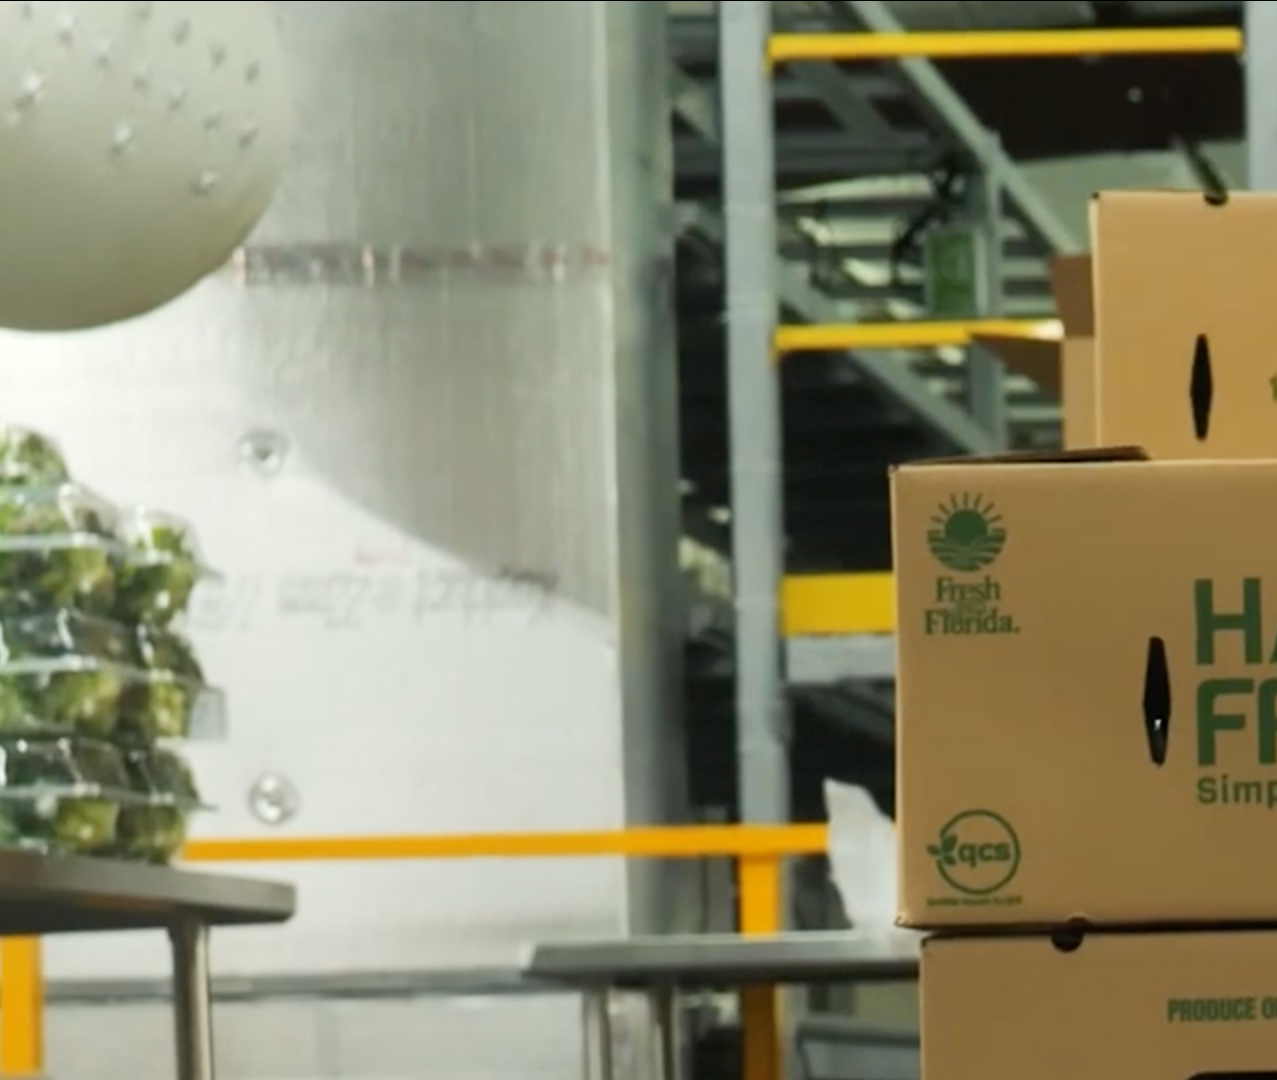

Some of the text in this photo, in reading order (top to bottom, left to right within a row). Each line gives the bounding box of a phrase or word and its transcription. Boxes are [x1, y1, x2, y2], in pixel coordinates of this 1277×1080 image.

[936, 576, 1001, 601] Fresh
[957, 842, 1011, 868] qcs
[1168, 998, 1255, 1021] PRODUCE
